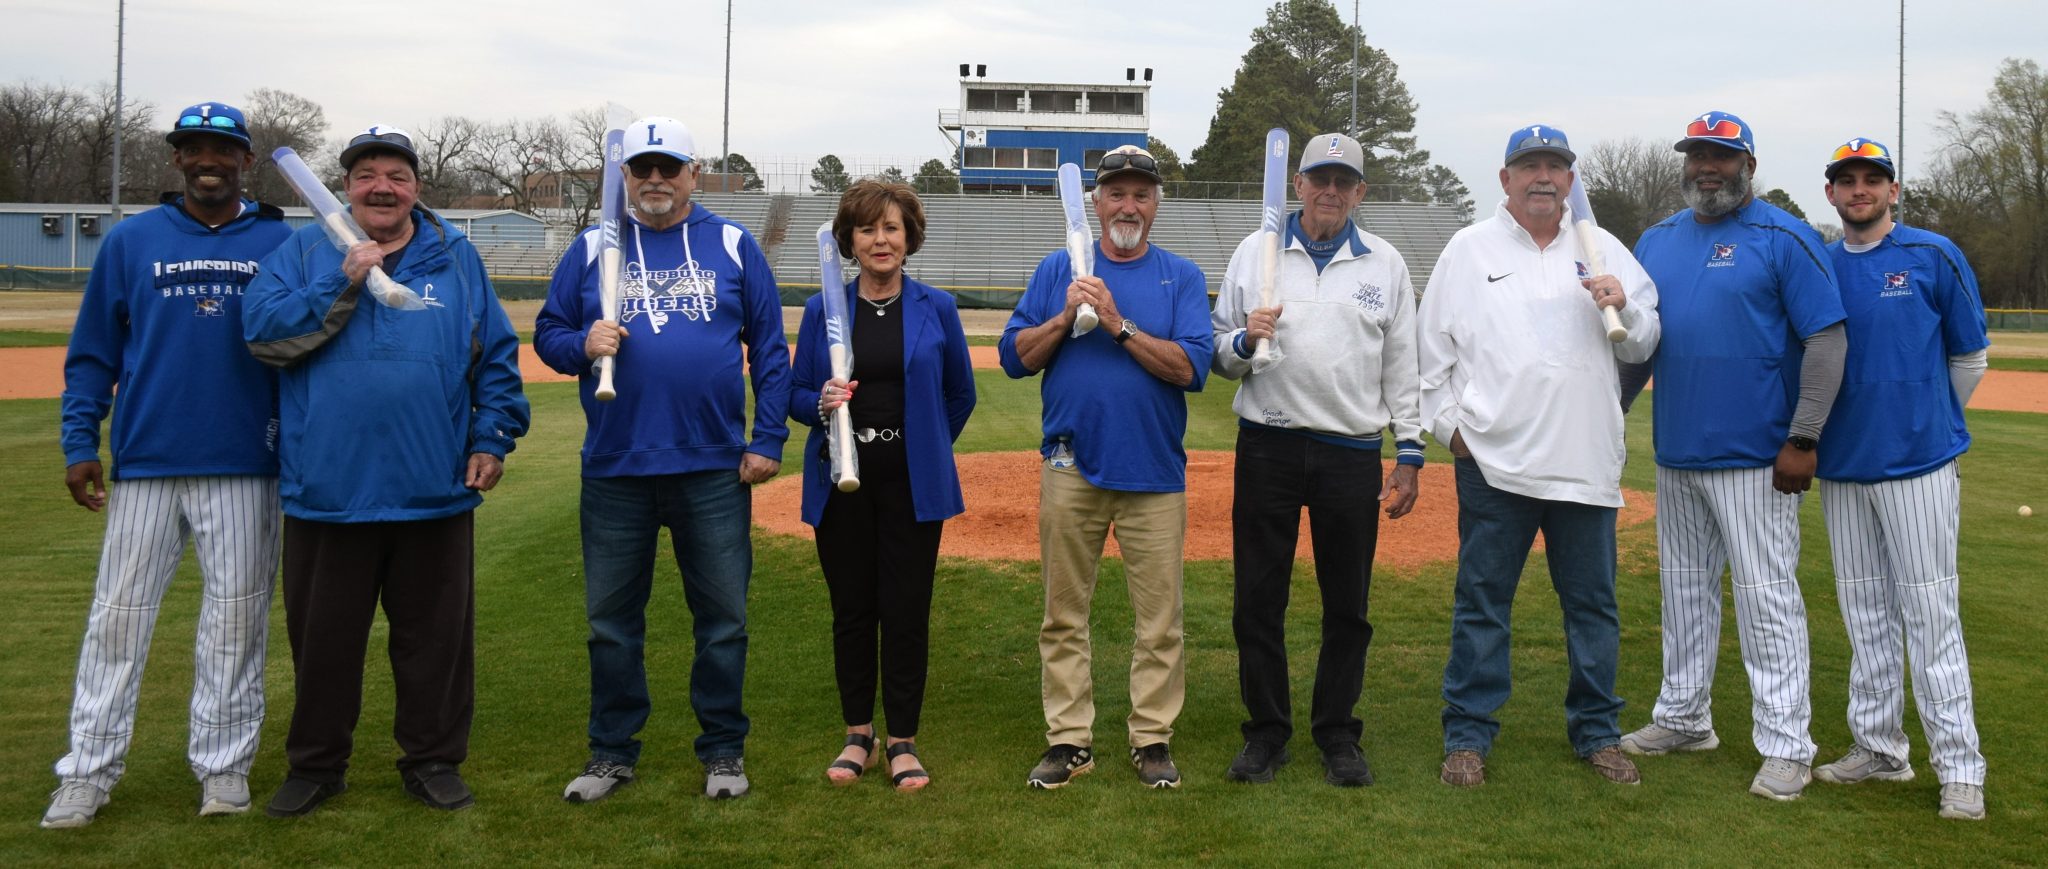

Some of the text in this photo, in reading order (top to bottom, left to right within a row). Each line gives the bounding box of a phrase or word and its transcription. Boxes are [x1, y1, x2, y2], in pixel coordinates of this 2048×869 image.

[647, 124, 663, 146] L
[1326, 136, 1344, 157] L
[1706, 260, 1735, 268] BASEBALL
[163, 285, 245, 297] BASEBAL
[421, 283, 437, 300] L
[1358, 288, 1382, 300] STATE
[1880, 289, 1913, 298] BASEBALL
